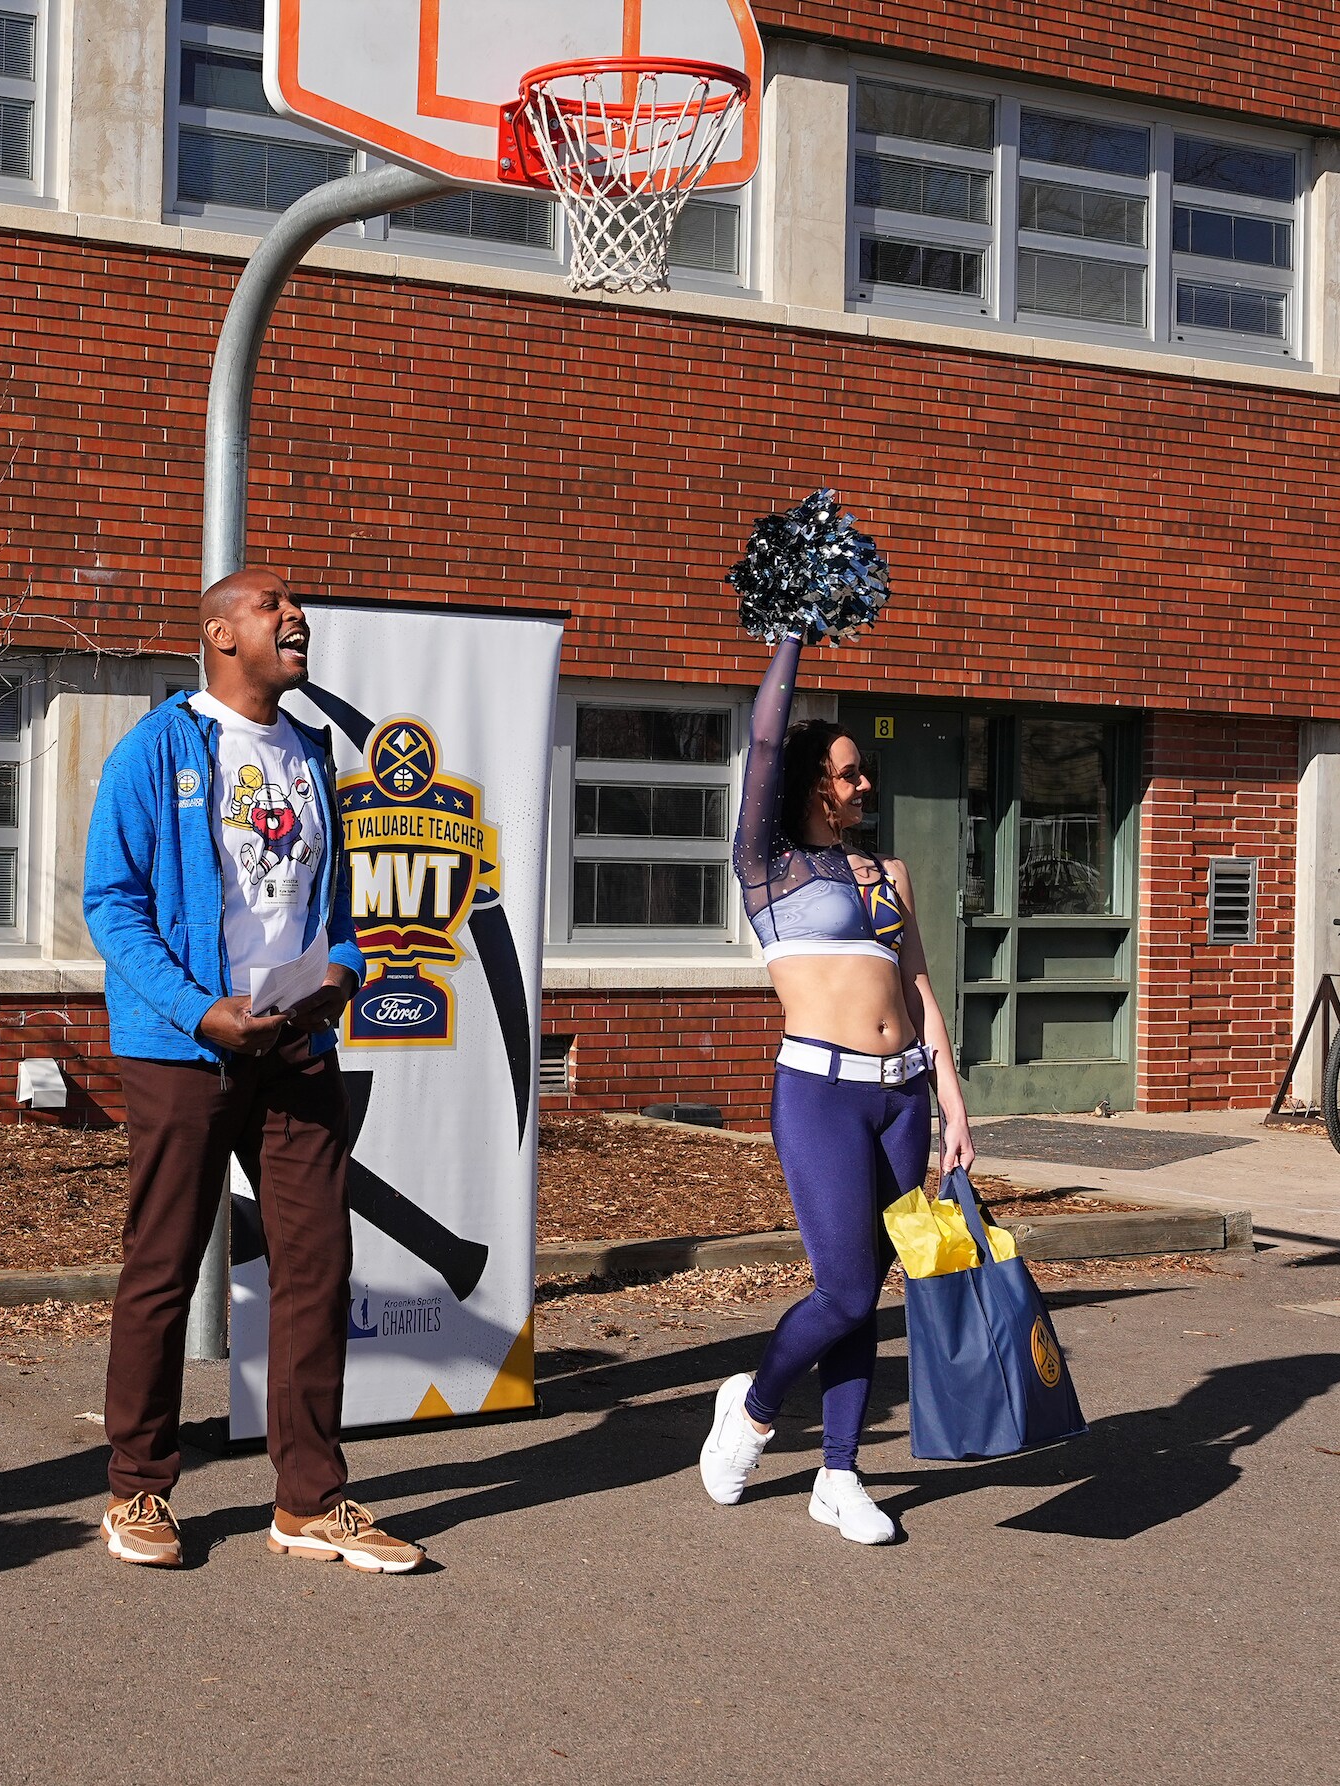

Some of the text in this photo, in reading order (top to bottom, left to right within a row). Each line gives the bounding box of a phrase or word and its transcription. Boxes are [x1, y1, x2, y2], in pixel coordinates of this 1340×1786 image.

[879, 719, 889, 736] 8
[358, 815, 424, 839] VALUABLE
[428, 817, 484, 852] TEACHER
[350, 851, 460, 918] MVT
[375, 998, 422, 1021] Ford
[384, 1297, 442, 1309] Kroenke Sports
[382, 1307, 441, 1336] CHARITIES
